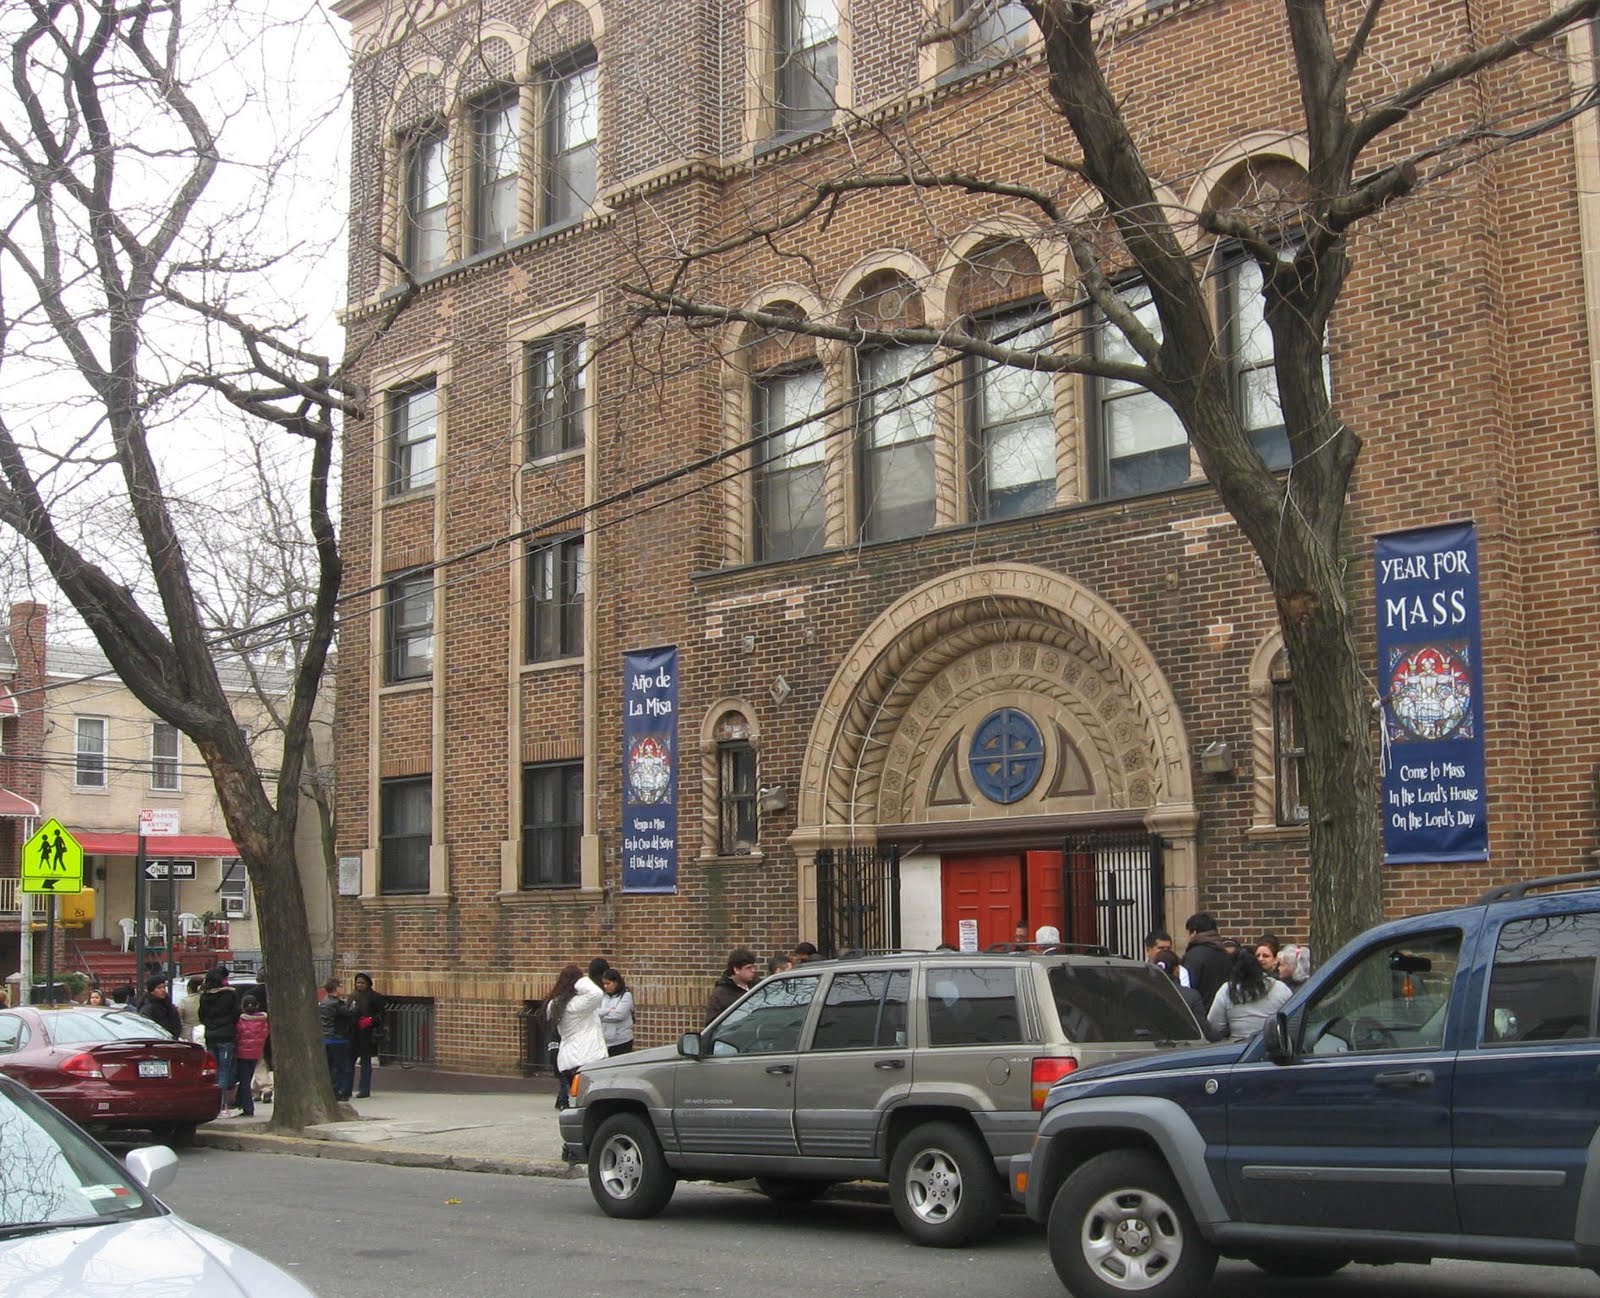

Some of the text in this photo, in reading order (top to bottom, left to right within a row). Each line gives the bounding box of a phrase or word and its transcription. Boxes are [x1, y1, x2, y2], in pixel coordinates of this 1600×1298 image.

[1381, 550, 1471, 584] YEAR FOR
[1385, 587, 1466, 631] MASS
[632, 666, 671, 693] Año de
[909, 571, 1052, 617] PATRIOTISM
[1087, 606, 1183, 776] KNOWLEDGE
[629, 698, 672, 717] La Misa
[1400, 761, 1466, 782] Come to Mass
[1389, 783, 1479, 807] In the Lord's House
[142, 810, 152, 821] NO
[633, 817, 648, 832] Venga
[1392, 807, 1475, 831] On the Lord's Day
[651, 834, 659, 850] del
[151, 866, 189, 874] ONE WAY
[630, 854, 636, 870] El
[646, 853, 654, 870] del
